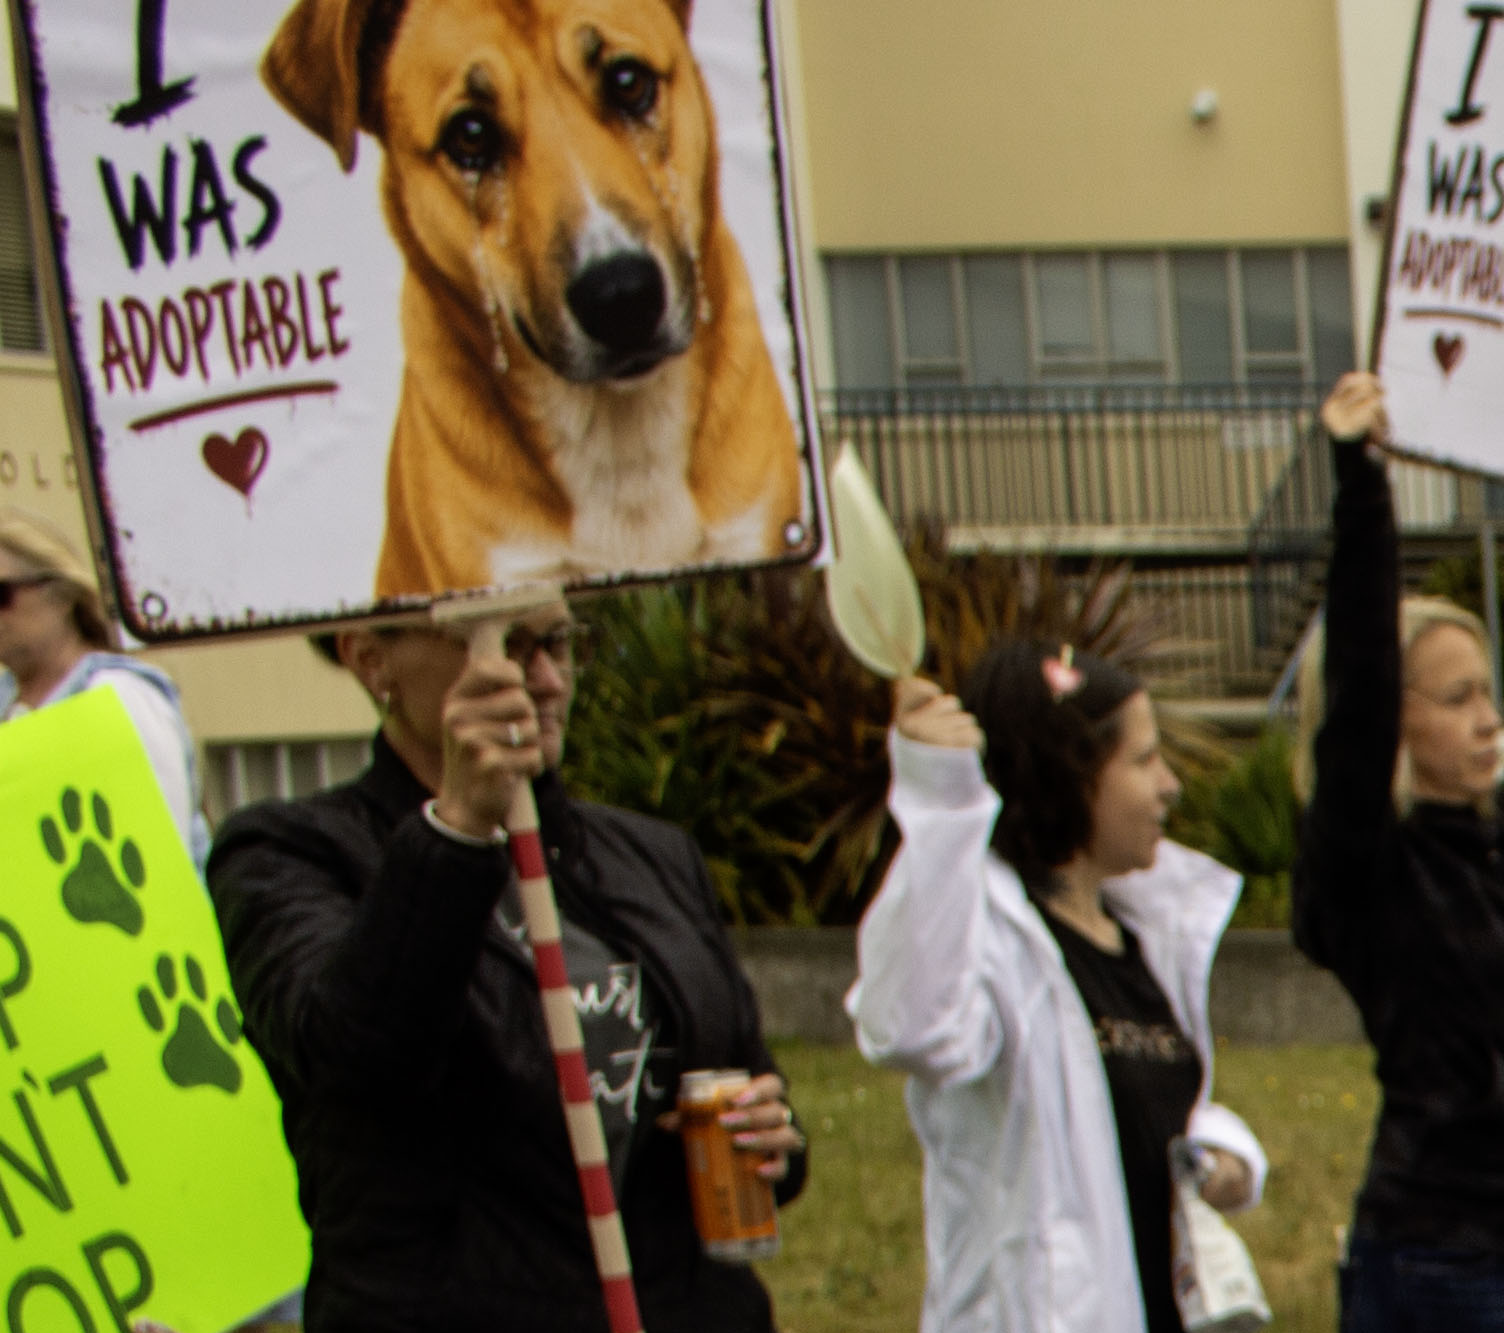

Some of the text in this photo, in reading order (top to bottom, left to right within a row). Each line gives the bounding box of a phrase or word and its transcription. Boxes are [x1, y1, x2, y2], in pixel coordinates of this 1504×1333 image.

[112, 0, 196, 129] I
[98, 135, 282, 270] WAS
[99, 267, 350, 394] ADOPTABLE
